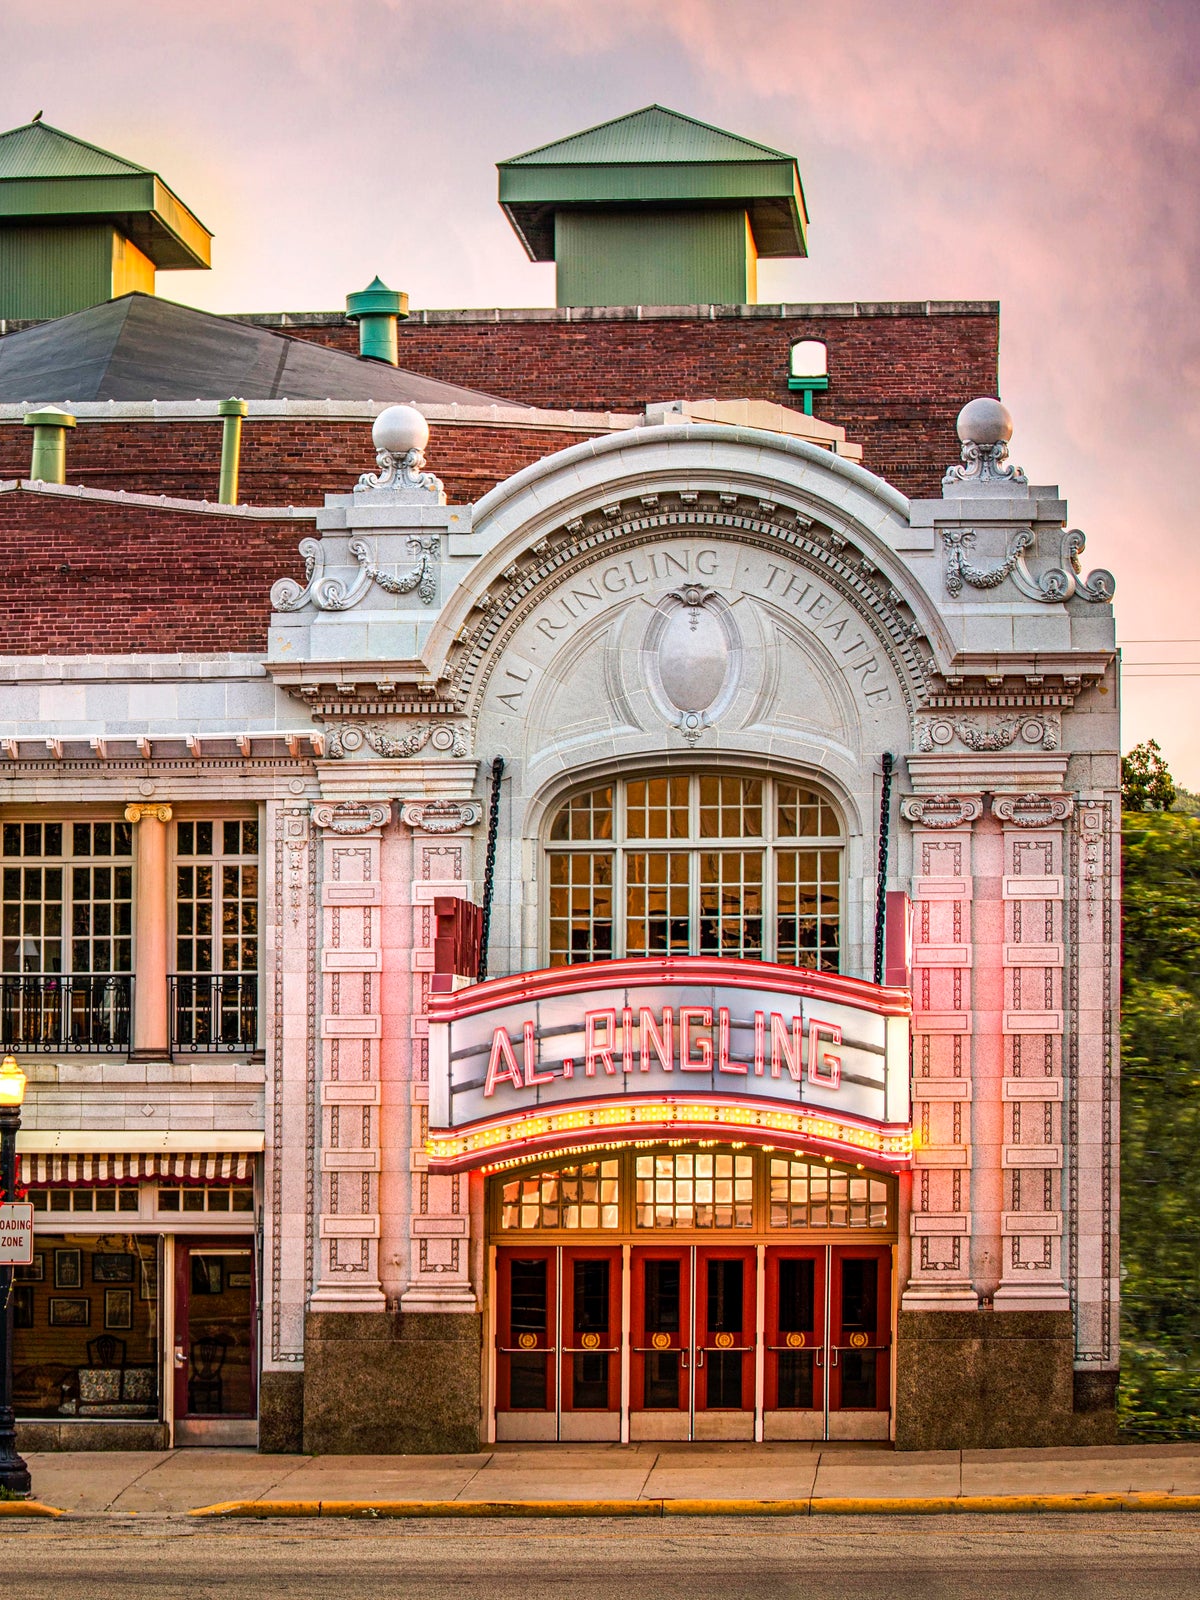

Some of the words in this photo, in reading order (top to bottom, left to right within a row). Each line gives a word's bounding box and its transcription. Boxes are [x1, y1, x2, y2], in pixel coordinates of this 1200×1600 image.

[496, 667, 533, 711] AL
[535, 550, 720, 640] RINGLING
[763, 563, 892, 709] THEATRE
[585, 1005, 842, 1091] RINGLING
[1, 1236, 24, 1247] ZONE
